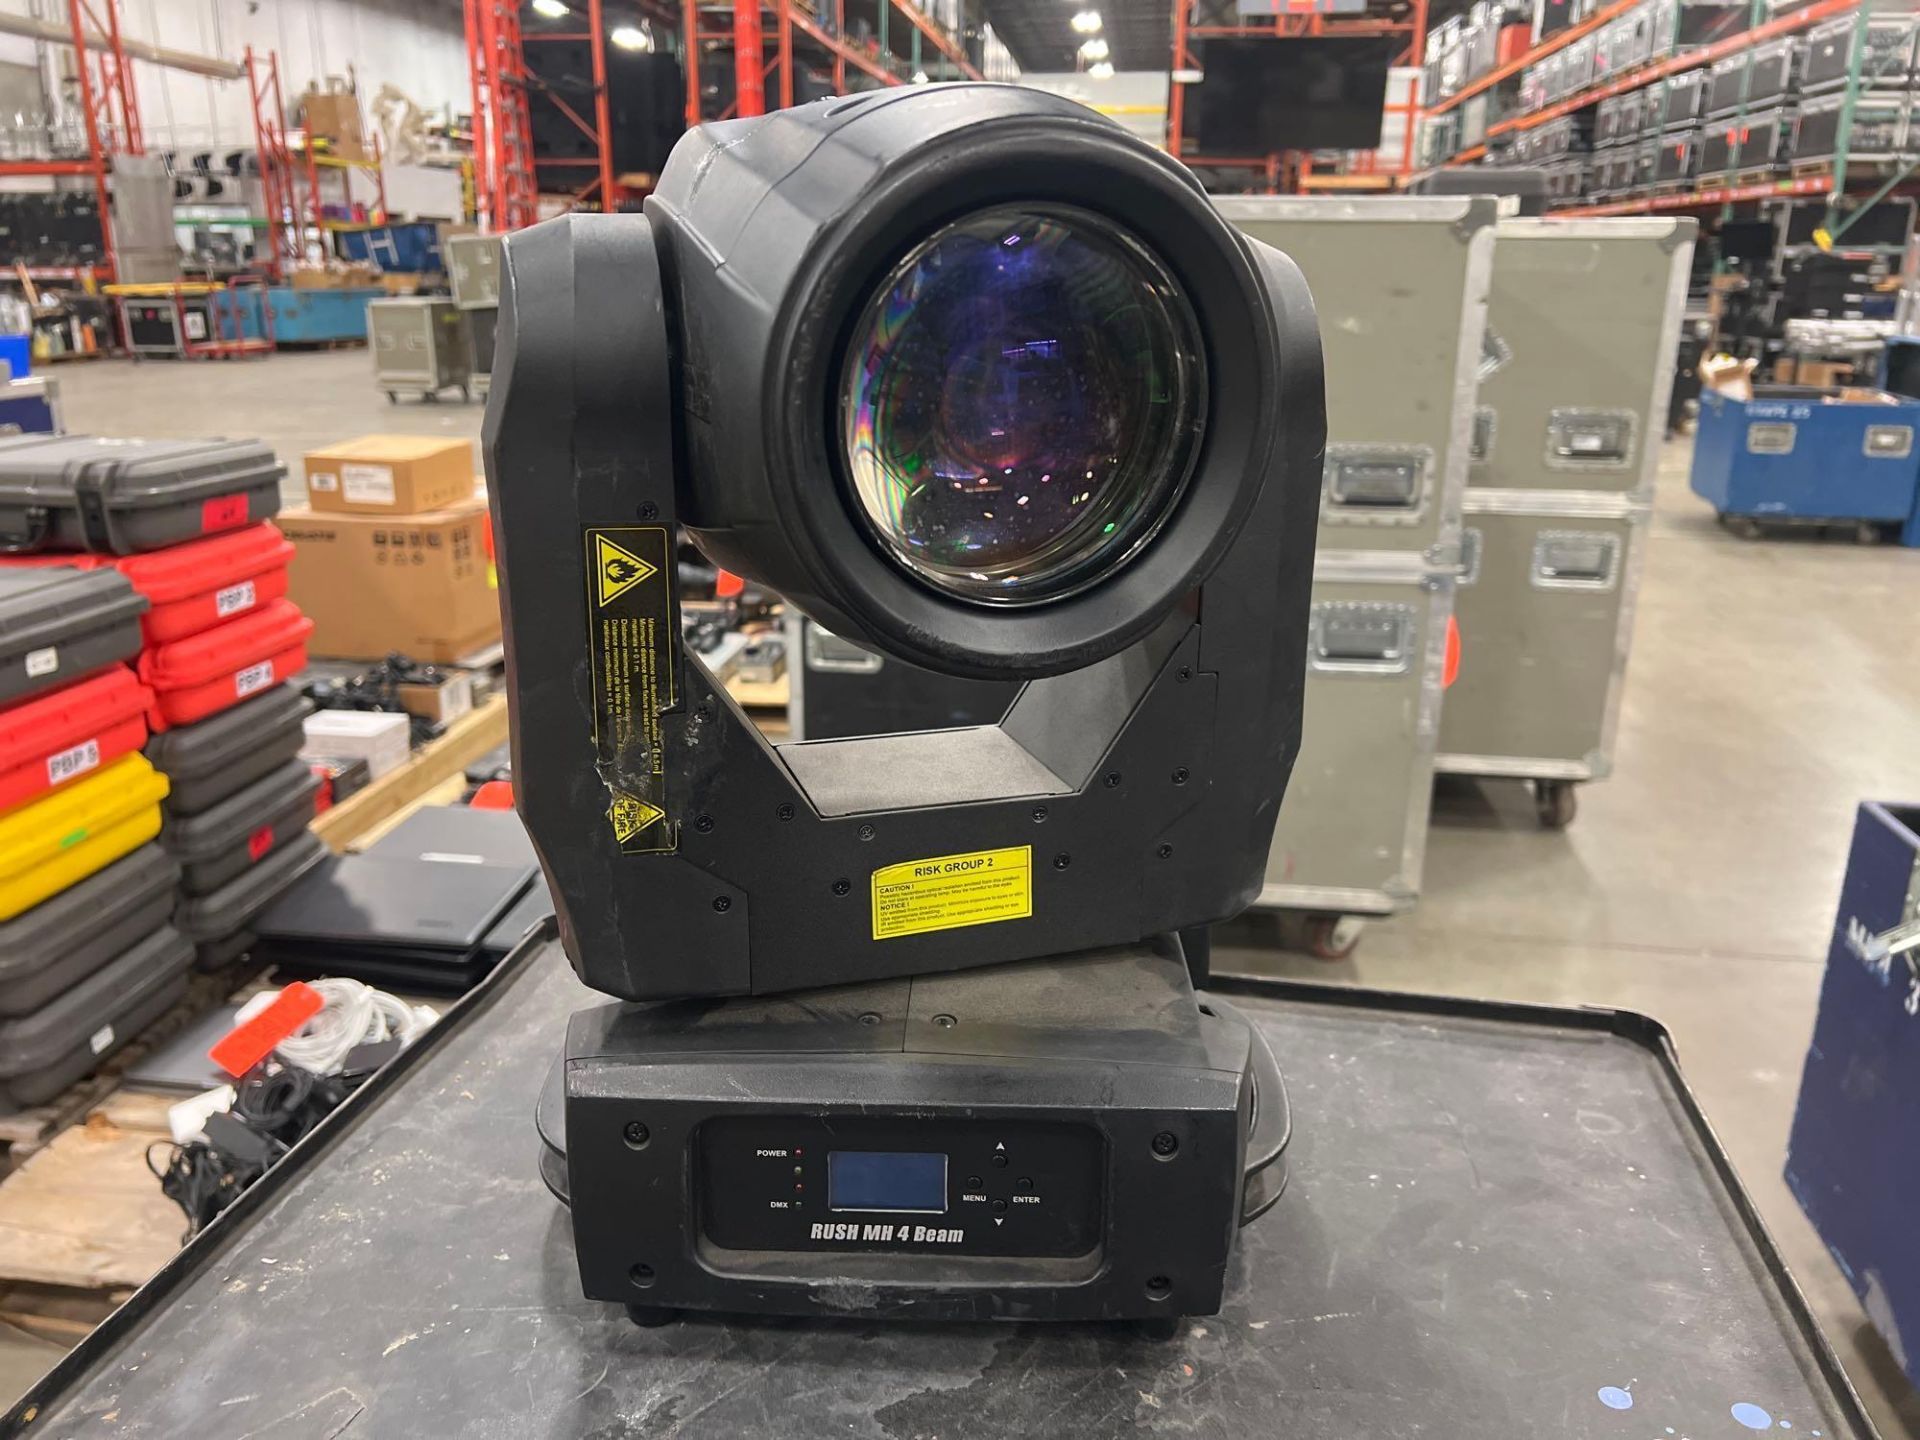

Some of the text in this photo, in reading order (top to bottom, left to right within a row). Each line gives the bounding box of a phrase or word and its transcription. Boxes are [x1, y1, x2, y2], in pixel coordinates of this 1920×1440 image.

[51, 748, 84, 779] PBP
[617, 813, 627, 834] FIRE
[914, 858, 993, 877] RISK GROUP 2
[879, 885, 910, 894] CAUTION
[879, 903, 905, 911] NOTICE
[963, 1194, 987, 1202] MENU
[1012, 1196, 1041, 1204] ENTER
[770, 1201, 789, 1209] DMX
[810, 1223, 964, 1243] RUSH MH 4 Beam
